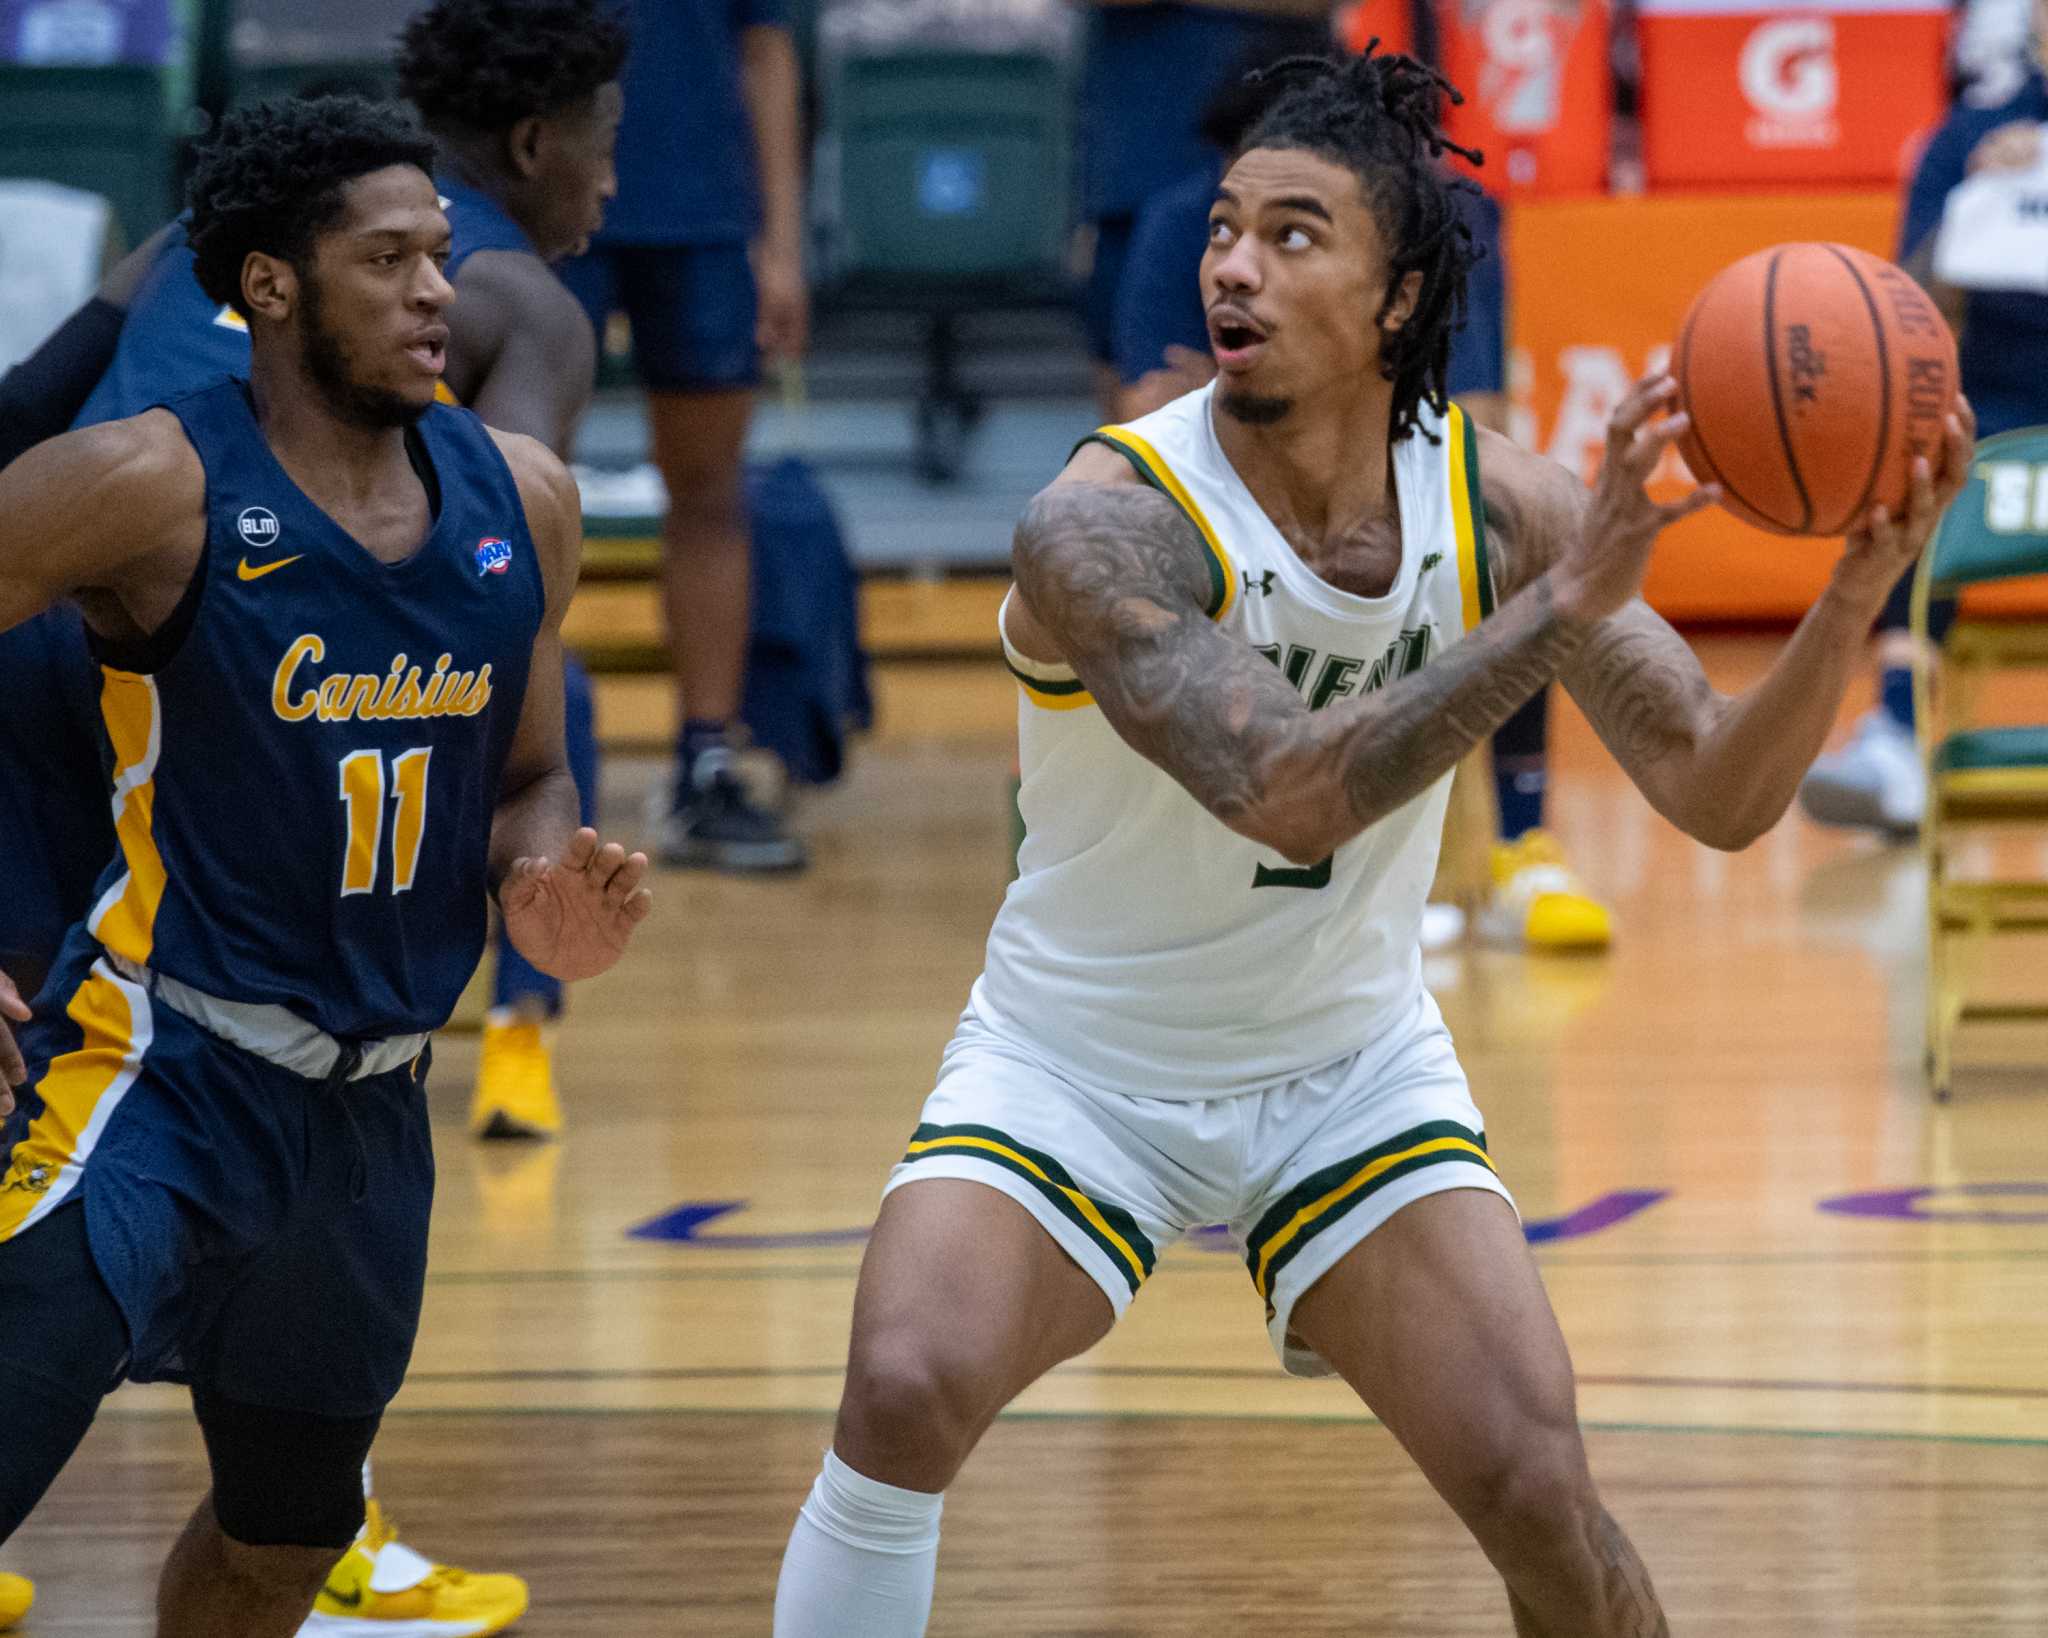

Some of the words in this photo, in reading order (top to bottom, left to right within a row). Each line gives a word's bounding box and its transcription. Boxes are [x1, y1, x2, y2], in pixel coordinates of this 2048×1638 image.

[1739, 20, 1838, 113] G
[242, 518, 276, 534] BLM
[272, 634, 492, 721] Canisius
[339, 746, 433, 898] 11
